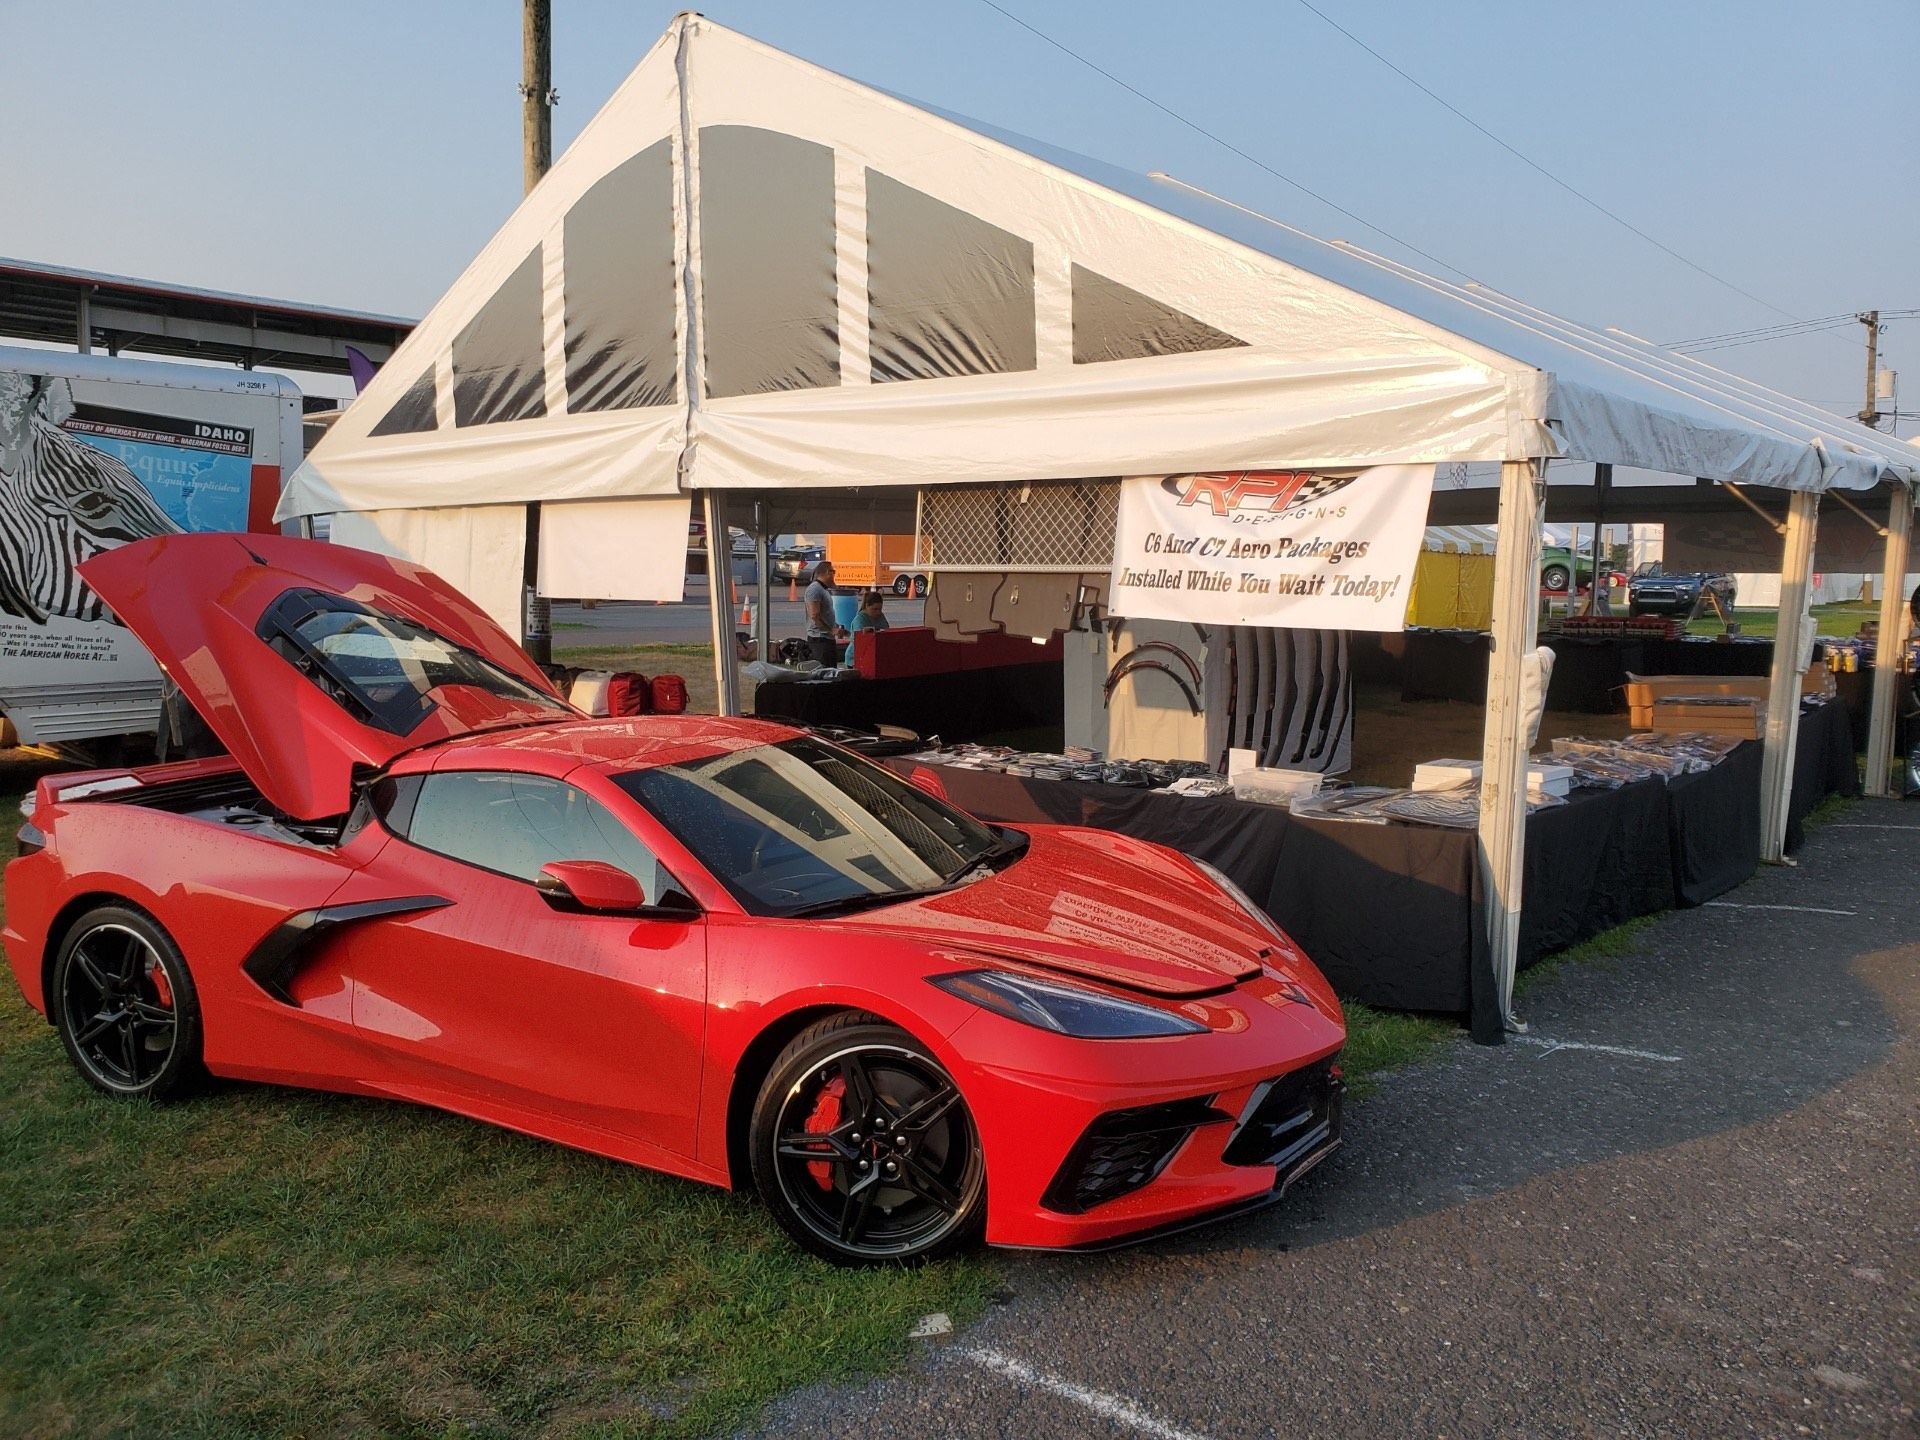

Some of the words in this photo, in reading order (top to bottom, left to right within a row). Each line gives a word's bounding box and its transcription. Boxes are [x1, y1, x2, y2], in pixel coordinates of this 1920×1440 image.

[65, 420, 95, 431] MYSTERY
[104, 426, 137, 437] AMERICA'S
[137, 431, 155, 439] FIRST
[155, 433, 176, 443] HORSE
[211, 442, 231, 451] FOSSIL
[195, 424, 246, 442] IDAHO
[119, 444, 200, 482] Equus
[1176, 470, 1315, 517] RPI
[1144, 532, 1162, 553] C6
[1163, 533, 1201, 554] And
[1200, 537, 1227, 557] C7
[1225, 538, 1271, 559] Aero
[1274, 537, 1371, 564] Packages
[1118, 567, 1183, 590] Installed
[1186, 570, 1232, 592] While
[1237, 573, 1271, 593] You
[1279, 573, 1325, 596] Wait
[1330, 575, 1401, 603] Today!
[3, 648, 18, 657] THE
[20, 649, 61, 659] AMERICAN
[63, 650, 90, 660] HORSE
